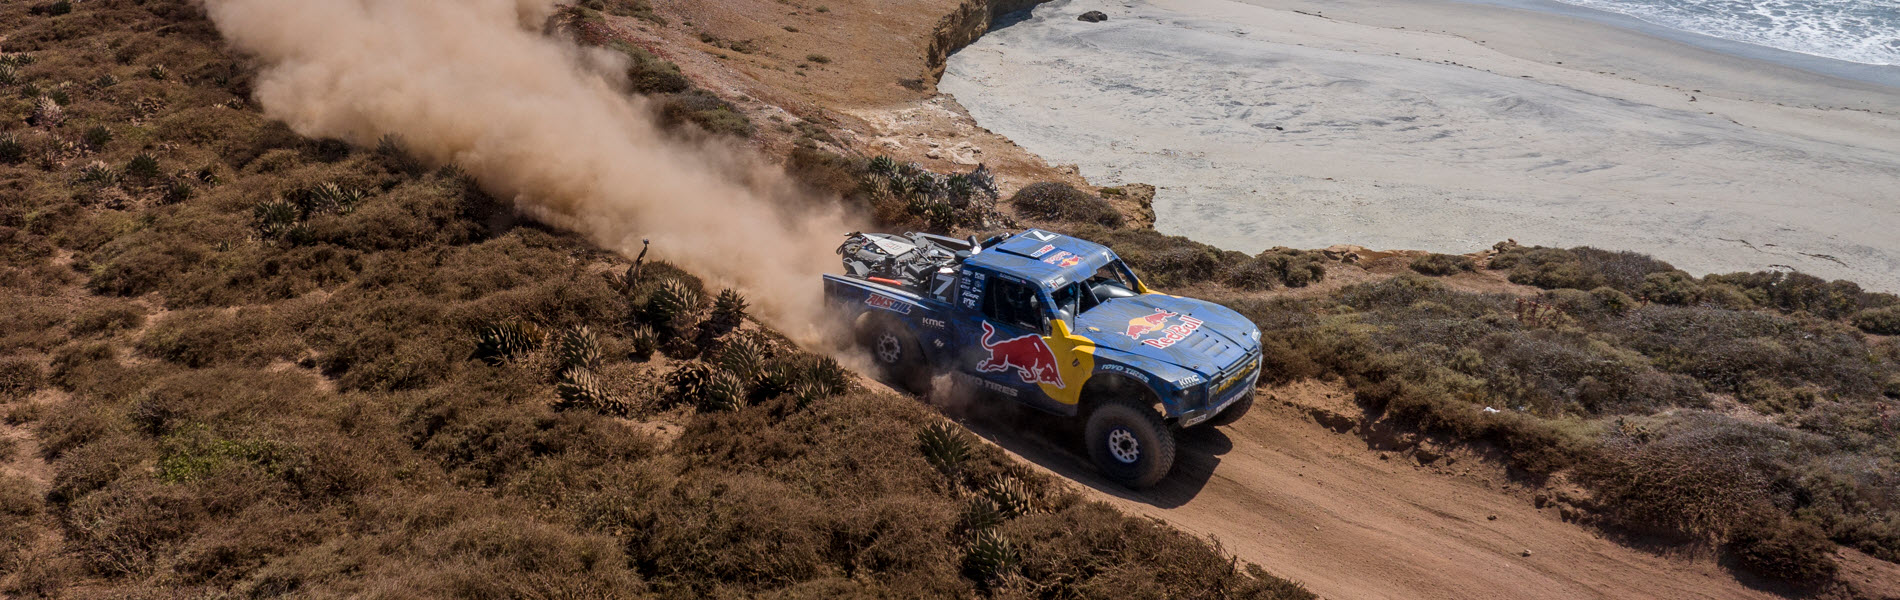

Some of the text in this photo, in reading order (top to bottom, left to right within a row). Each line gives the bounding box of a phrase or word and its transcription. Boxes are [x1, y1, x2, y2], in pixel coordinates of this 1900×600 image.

[933, 274, 954, 295] 7
[865, 293, 912, 315] AMSOIL
[984, 380, 1018, 397] TIRES
